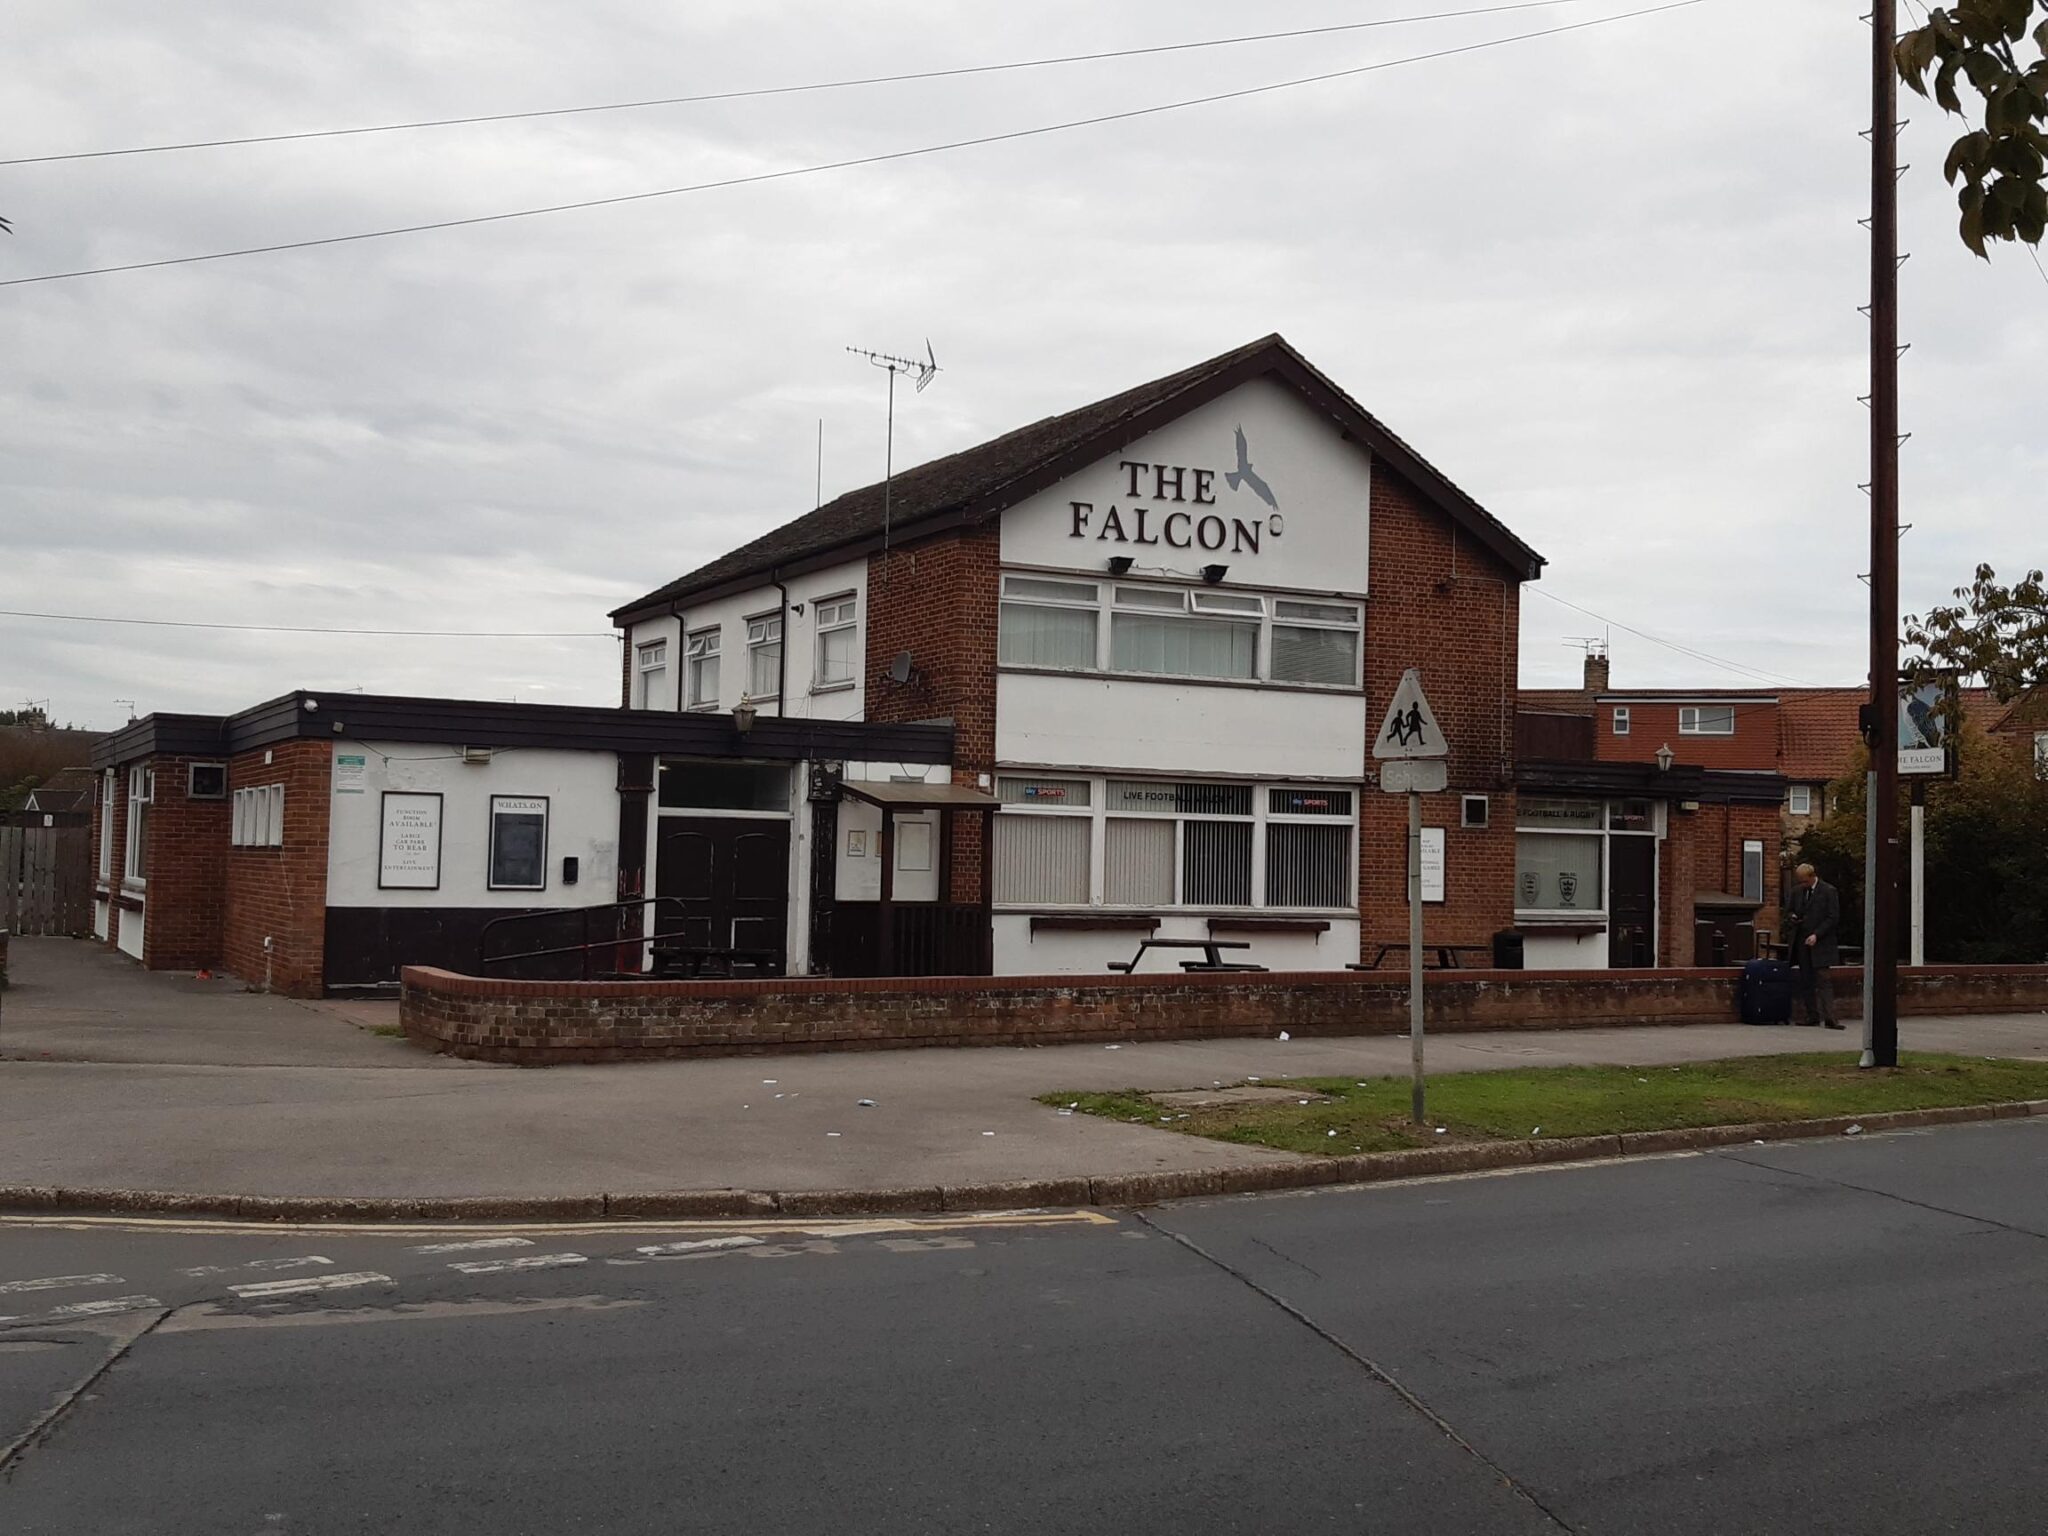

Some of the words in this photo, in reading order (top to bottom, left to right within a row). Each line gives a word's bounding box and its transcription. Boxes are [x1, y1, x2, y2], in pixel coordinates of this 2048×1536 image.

[1120, 461, 1216, 505] THE
[1069, 501, 1263, 555] FALCON
[1910, 755, 1942, 763] FALCON
[1385, 769, 1437, 785] Schoo
[1038, 788, 1066, 797] SPORTS
[1123, 791, 1143, 800] LIVE
[1145, 792, 1190, 802] FOOTB
[1523, 809, 1560, 818] FOOTBALL
[1572, 810, 1595, 819] RUGBY
